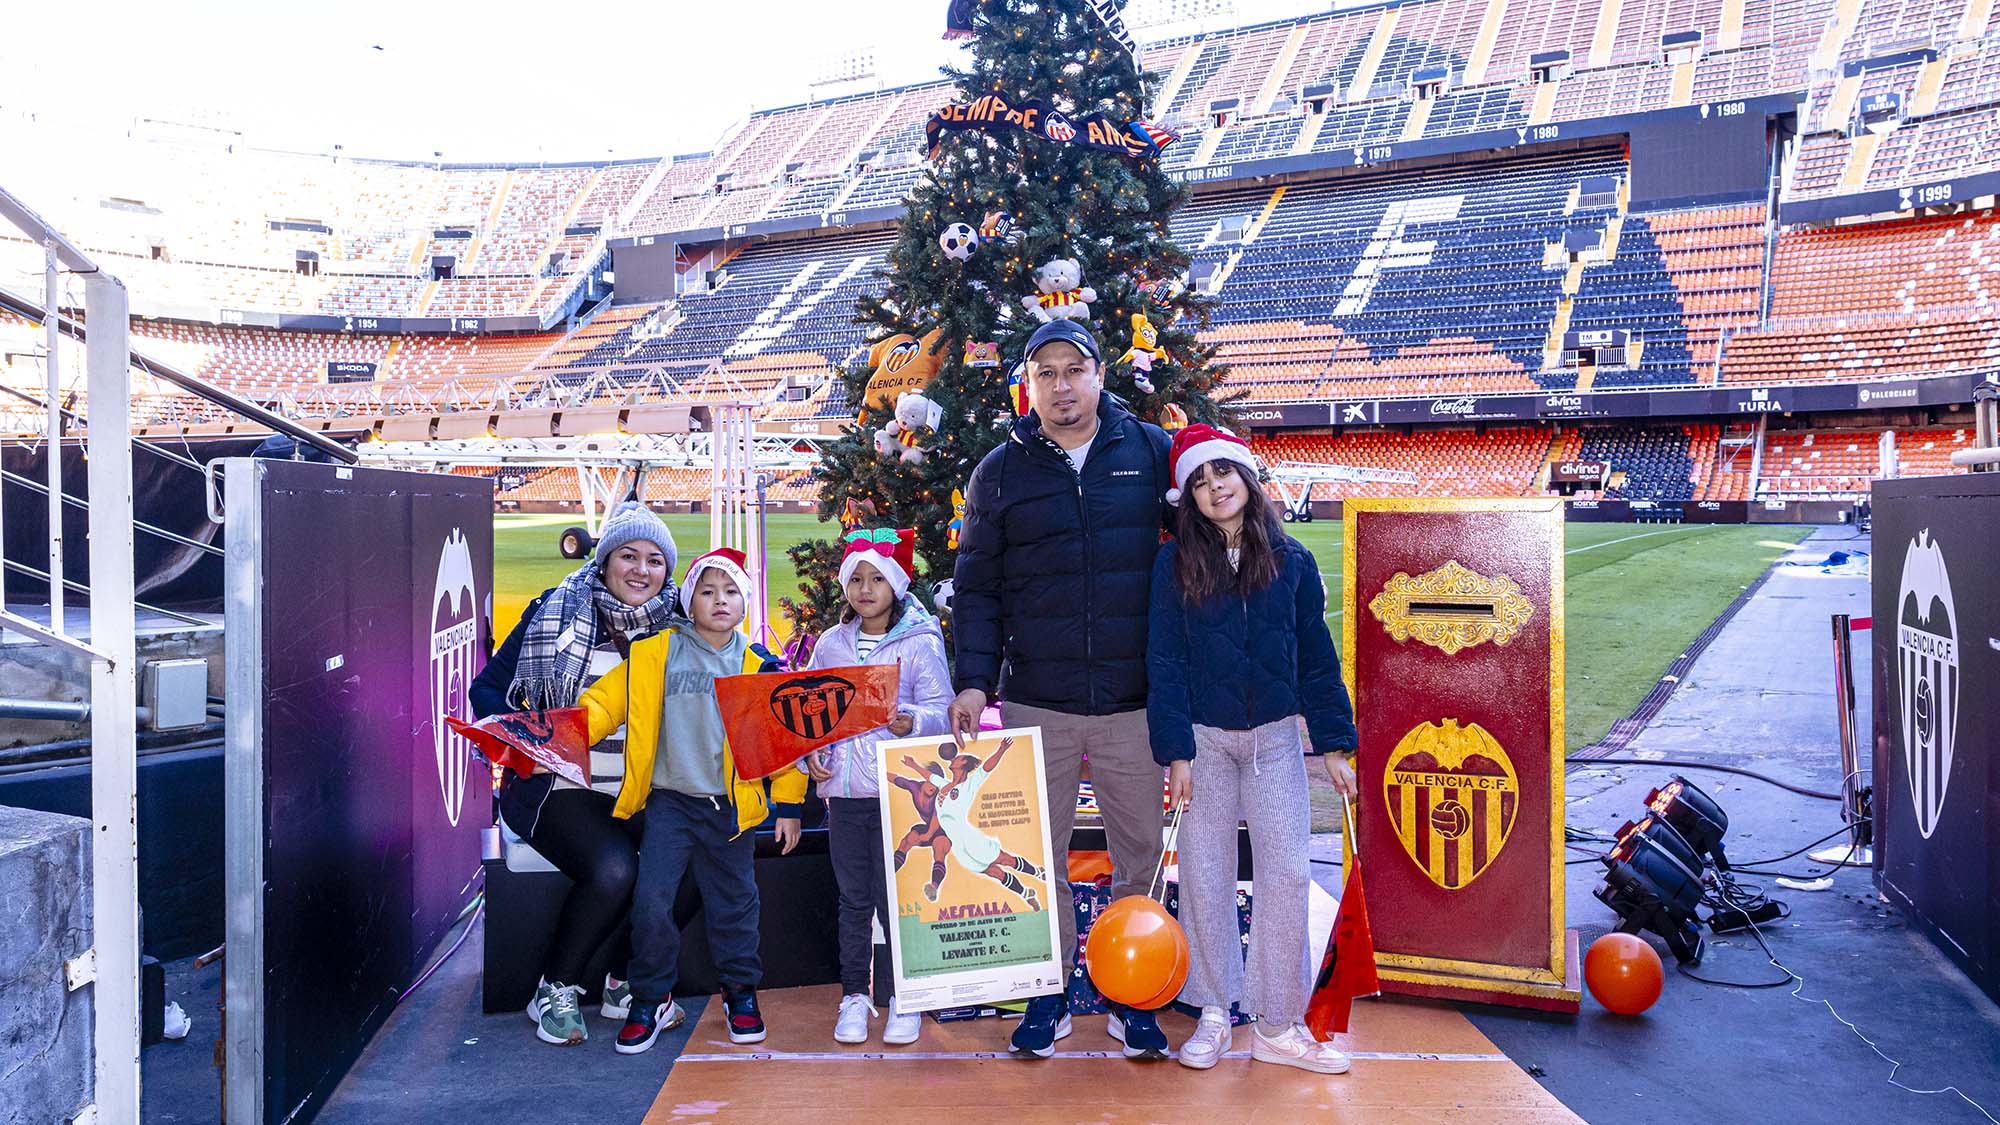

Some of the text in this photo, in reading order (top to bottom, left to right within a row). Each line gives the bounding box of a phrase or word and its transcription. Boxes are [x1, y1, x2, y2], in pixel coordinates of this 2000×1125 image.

[1090, 0, 1136, 54] NCIA
[1716, 102, 1746, 118] 1980
[1867, 101, 1896, 111] TURIA
[1533, 125, 1559, 139] 1980
[1368, 147, 1392, 160] 1979
[1206, 166, 1233, 179] FANS!
[1918, 184, 1952, 203] 1999
[358, 319, 378, 329] 1954
[460, 319, 479, 329] 1962
[867, 378, 904, 390] ALENCIA
[1546, 396, 1582, 407] divina
[1738, 401, 1782, 412] TURIA
[1560, 462, 1600, 474] divina
[434, 627, 465, 654] VALENCIA
[1901, 628, 1953, 662] VALENCIA C.F.
[666, 671, 714, 697] WISCO
[1394, 772, 1509, 790] VALENCIA C.F.
[938, 901, 1013, 921] MESTALLA
[939, 926, 1011, 943] VALENCIA F. C.
[942, 943, 1011, 961] LEVANTE F. C.
